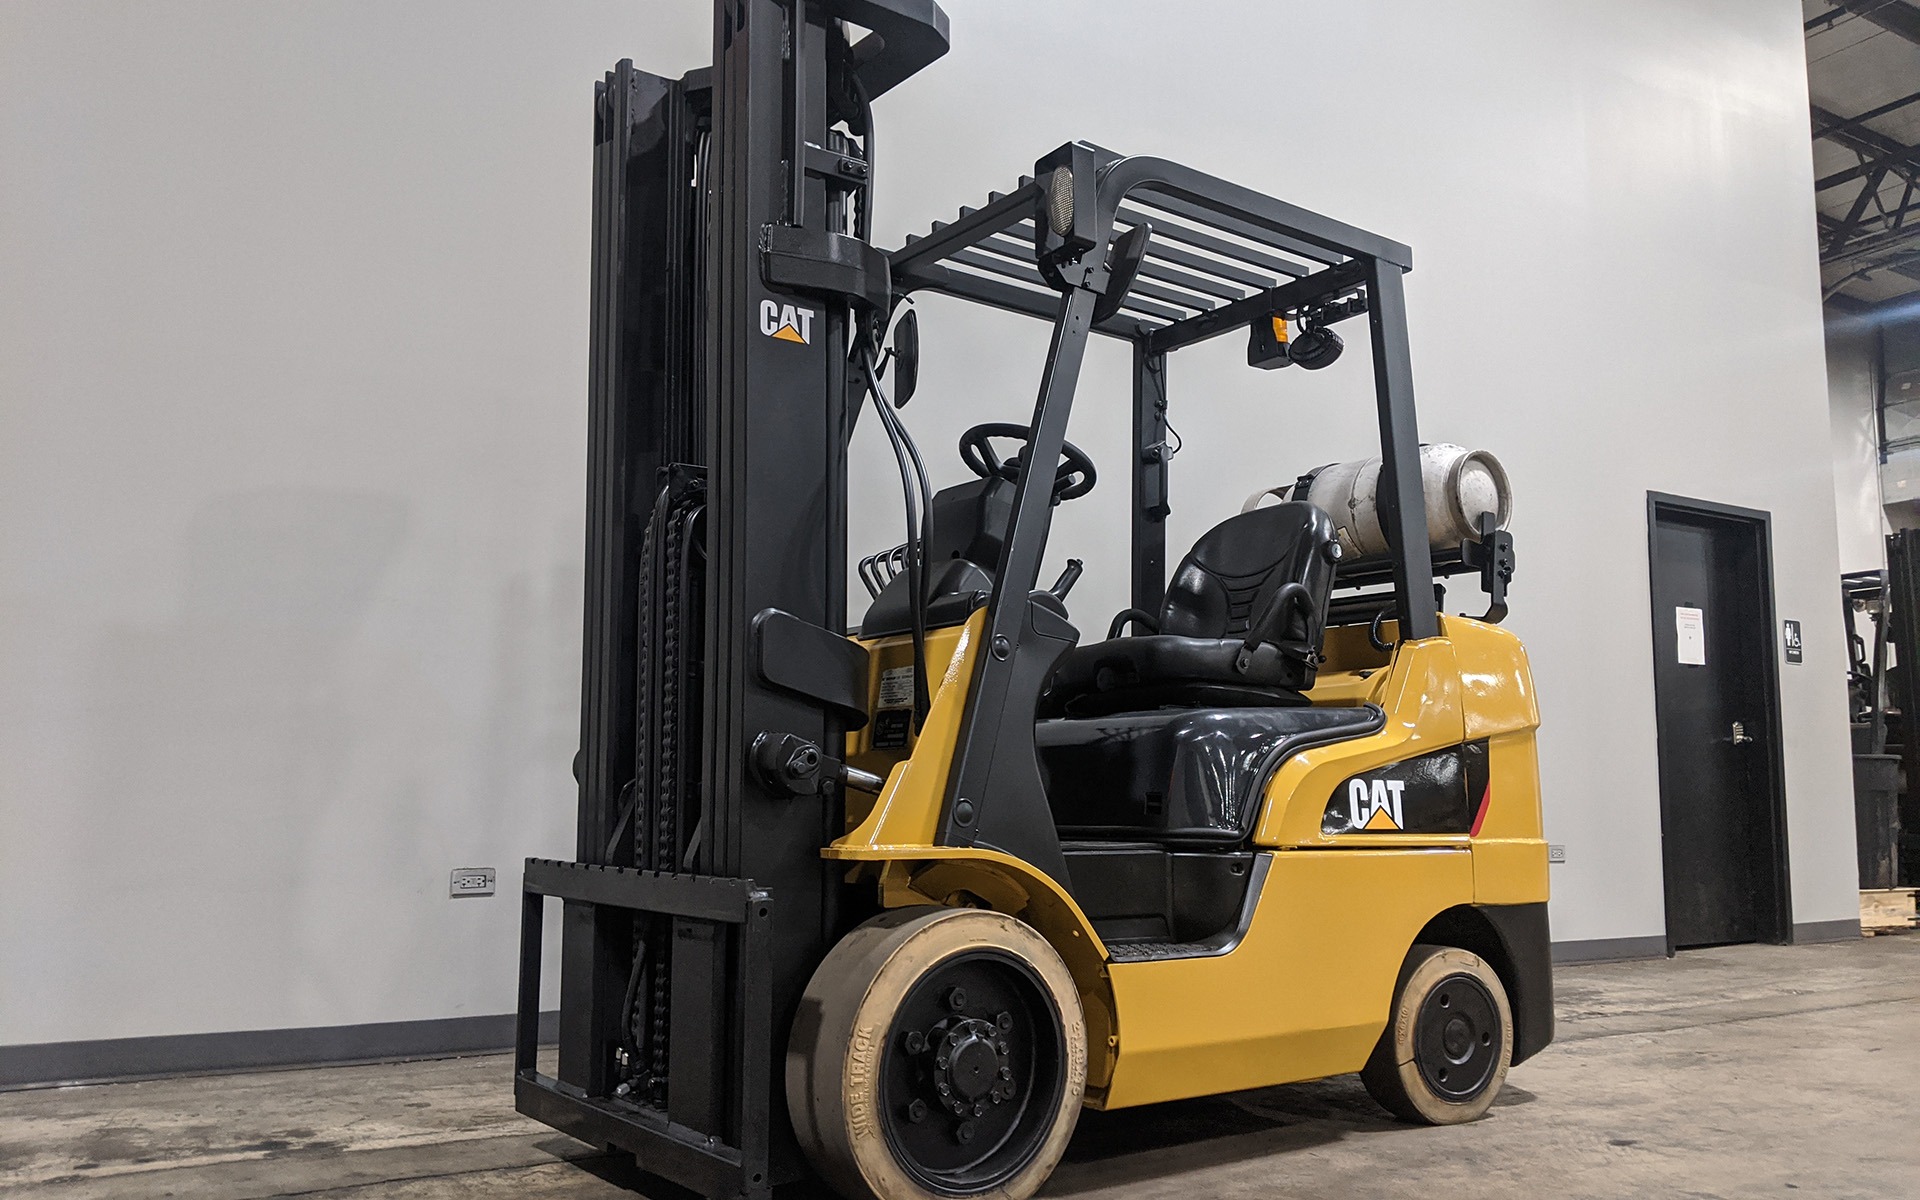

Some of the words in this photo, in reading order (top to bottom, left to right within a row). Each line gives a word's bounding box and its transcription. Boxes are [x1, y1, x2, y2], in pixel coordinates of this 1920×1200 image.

[760, 299, 815, 345] CAT
[1348, 778, 1405, 830] CAT
[850, 1026, 873, 1087] TRACK
[850, 1091, 869, 1140] WIDE
